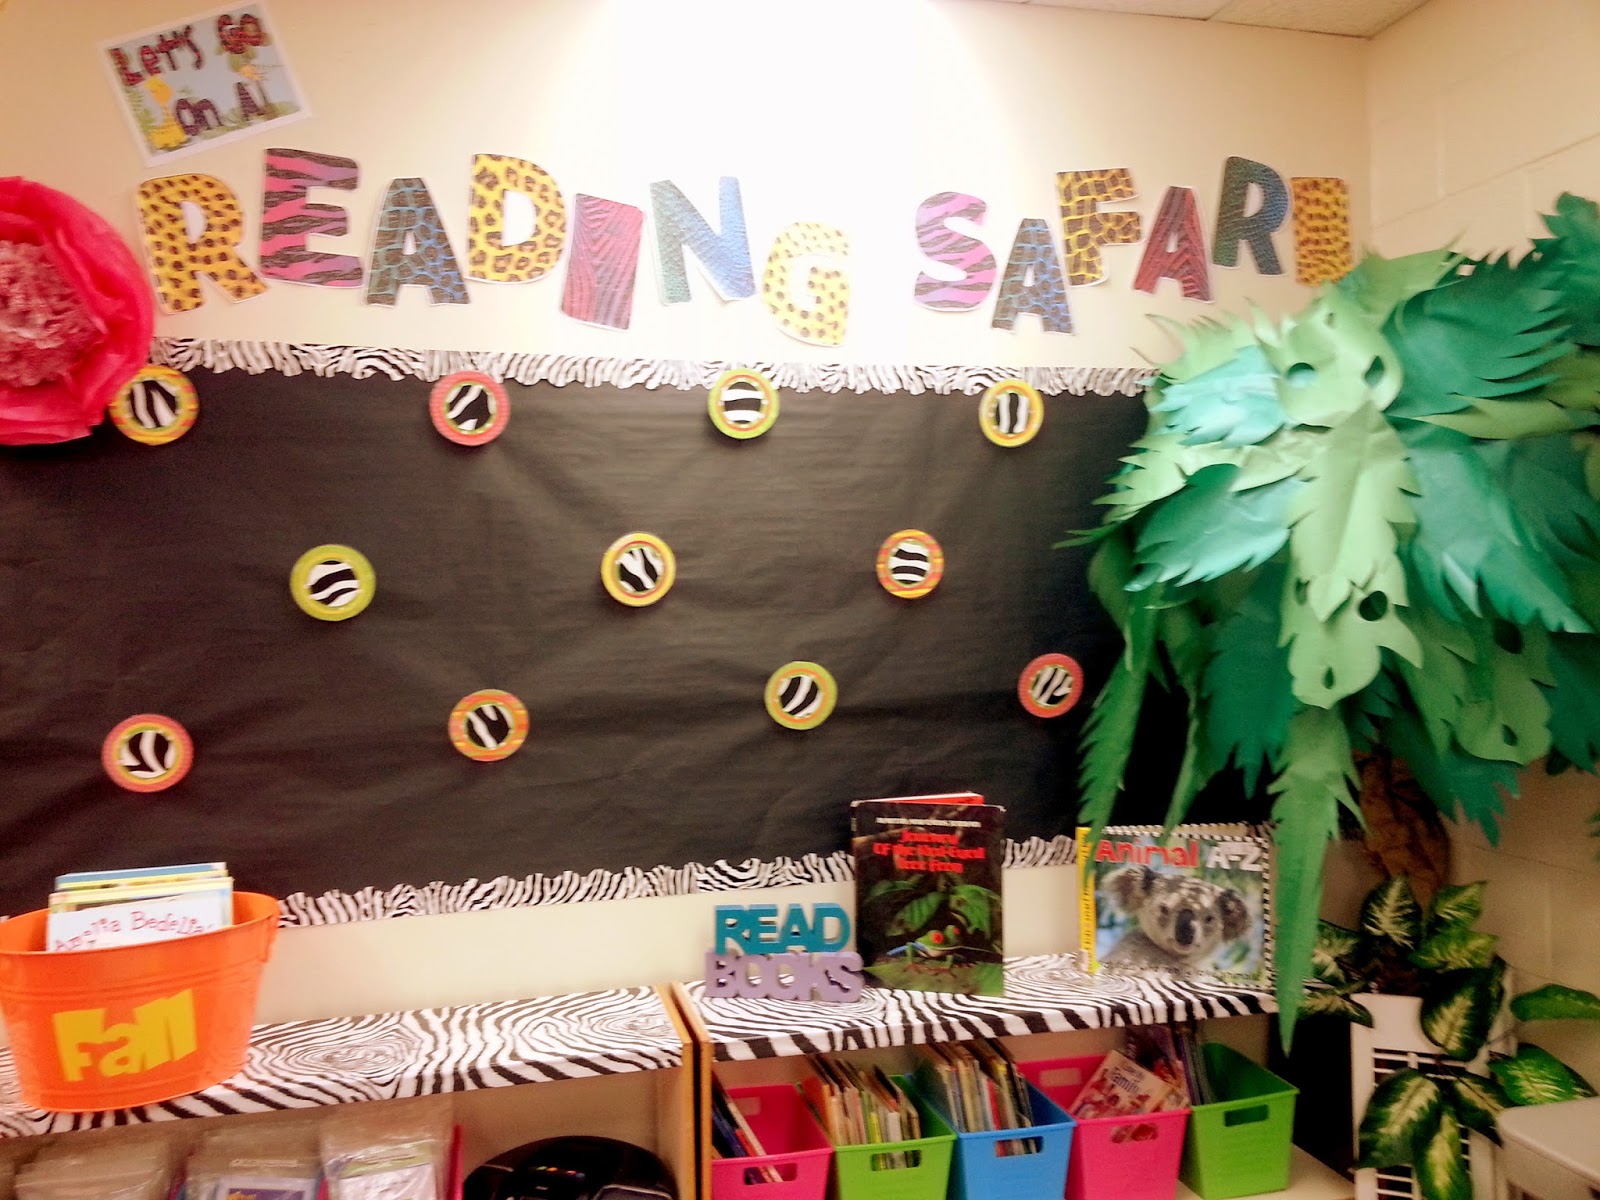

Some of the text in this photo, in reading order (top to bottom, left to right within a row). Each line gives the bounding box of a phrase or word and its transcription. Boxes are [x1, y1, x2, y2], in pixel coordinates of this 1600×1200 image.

[137, 147, 1352, 347] READING SAFARI
[1094, 837, 1264, 872] Animal A-Z
[715, 903, 850, 955] READ
[704, 952, 866, 1002] BOOKS
[53, 988, 197, 1082] Fall
